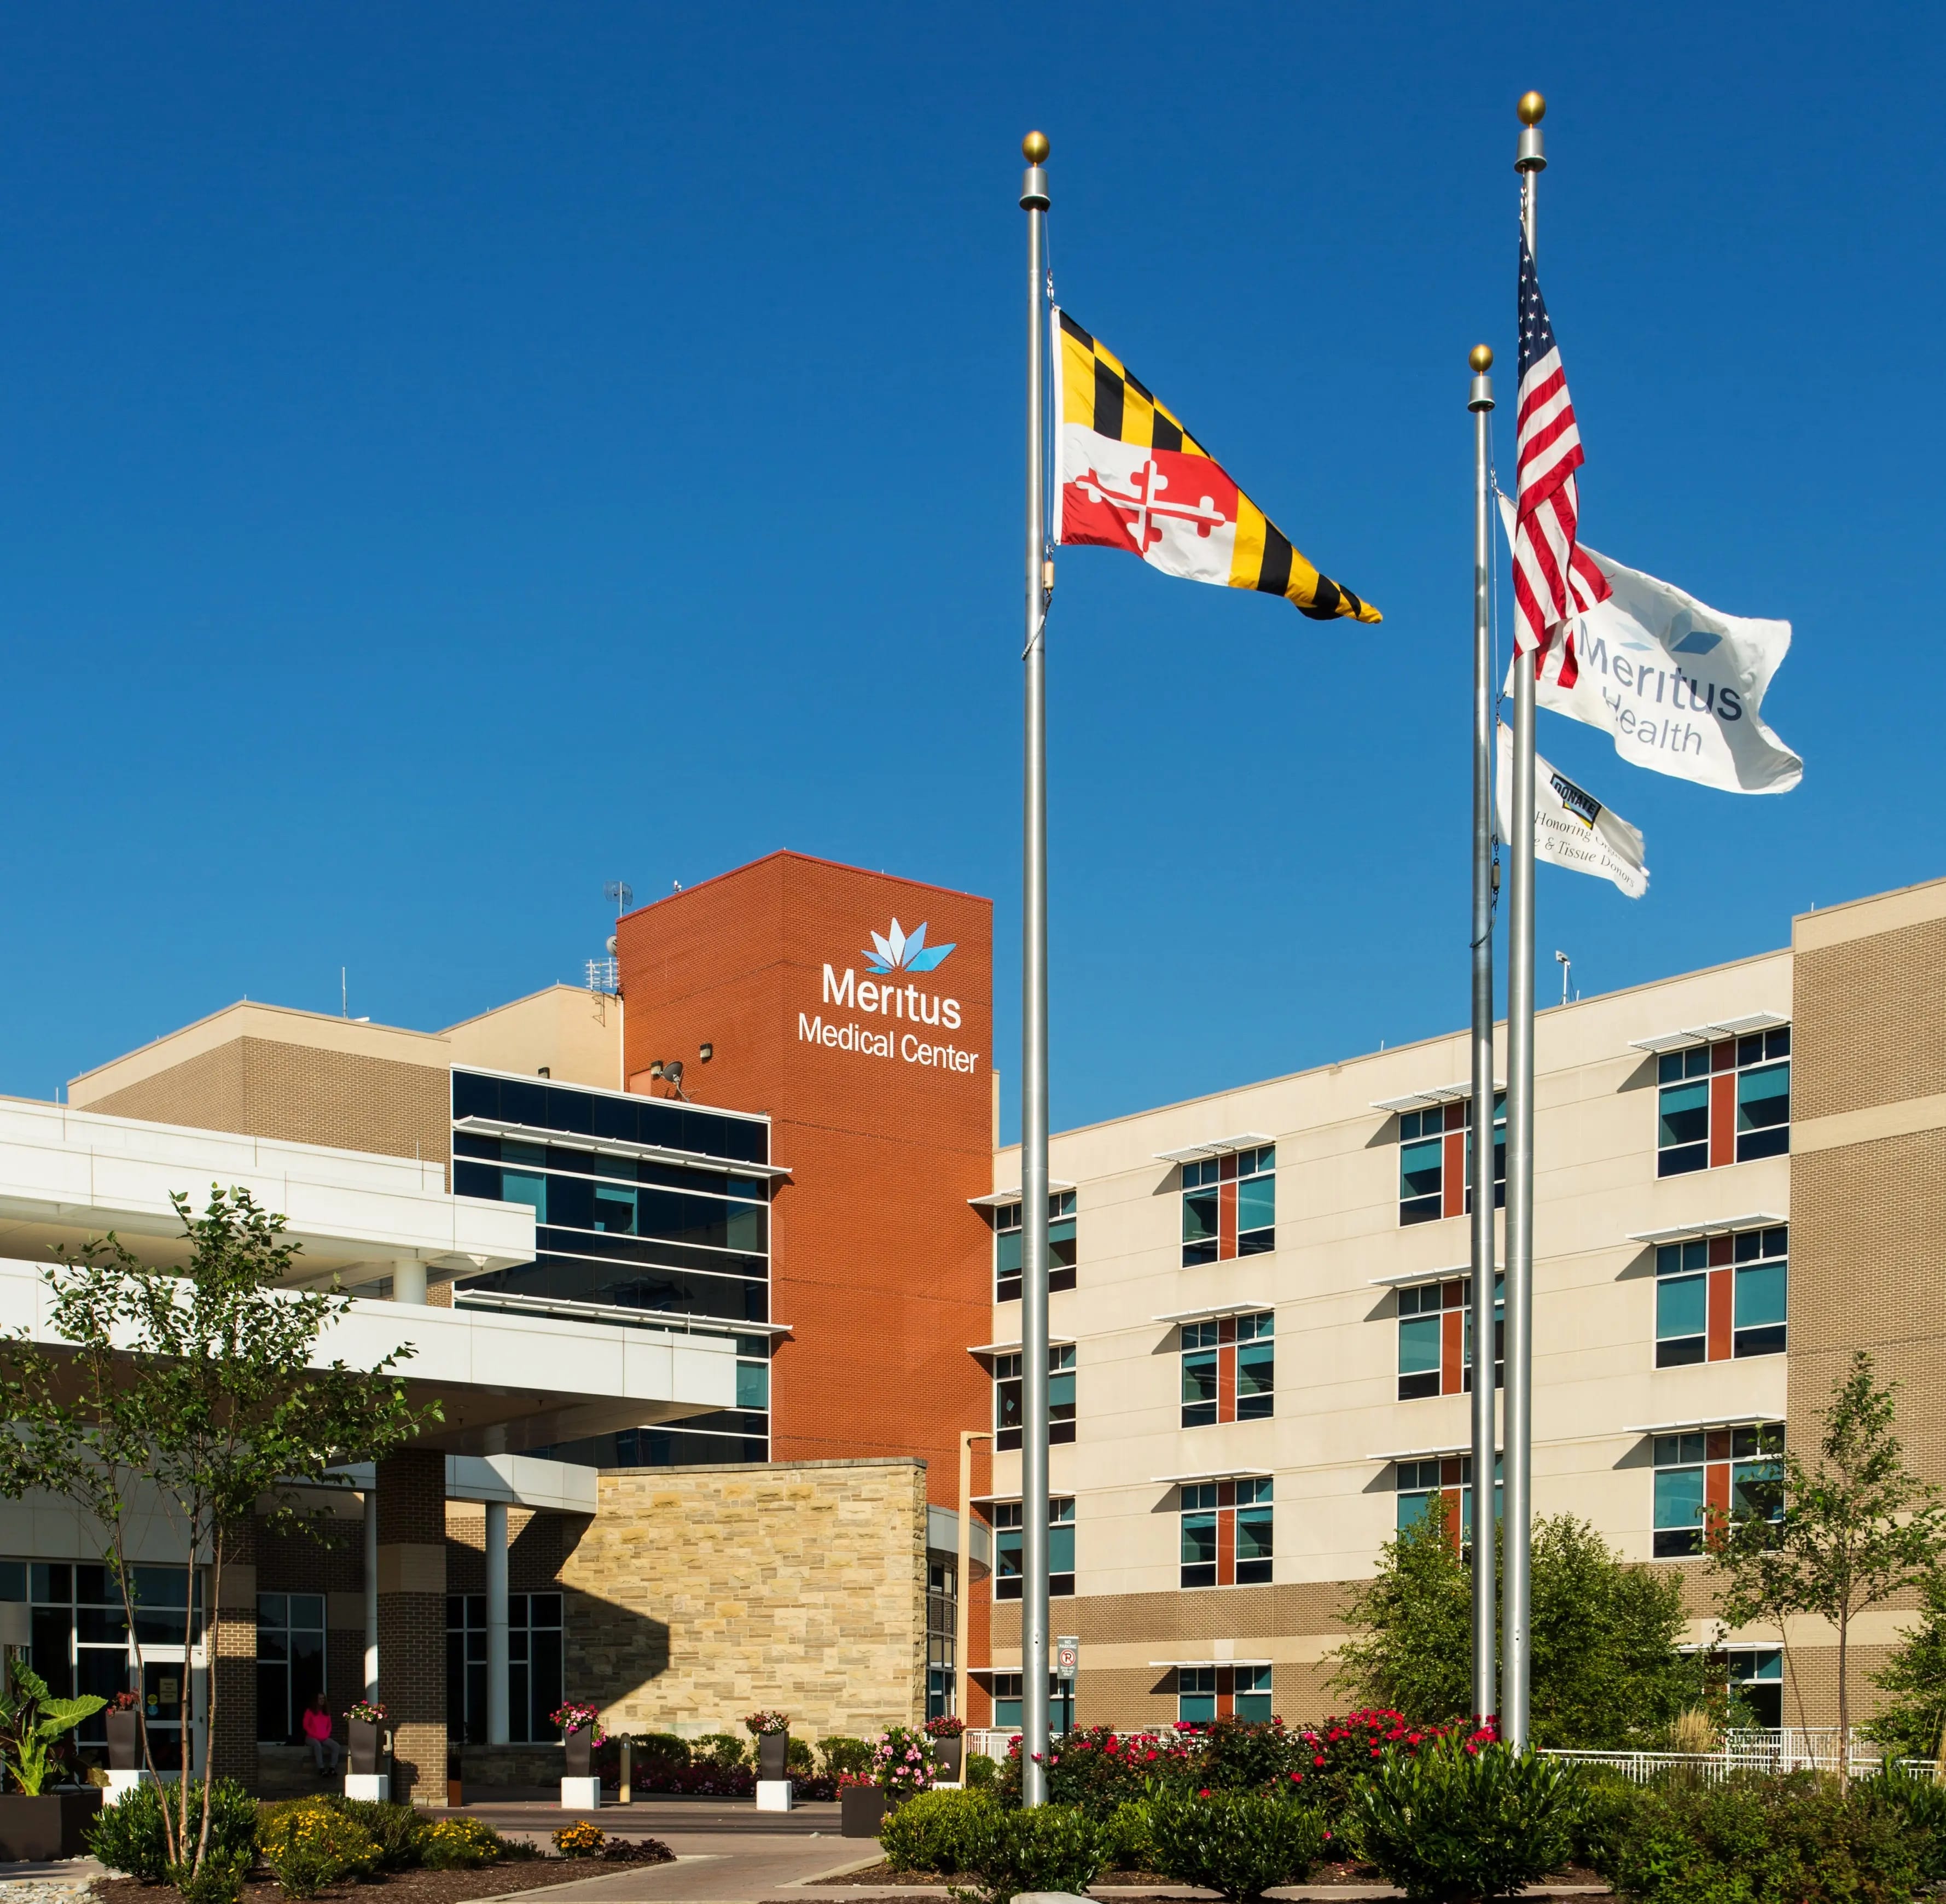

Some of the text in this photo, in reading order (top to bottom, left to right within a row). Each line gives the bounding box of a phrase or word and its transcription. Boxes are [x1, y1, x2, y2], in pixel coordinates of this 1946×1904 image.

[1579, 617, 1742, 721] Meritus
[1602, 686, 1702, 755] Health
[1535, 811, 1591, 843] Honoring
[1554, 782, 1596, 814] DONATE
[1545, 837, 1554, 851] &
[1558, 841, 1596, 862] Tissue
[1601, 855, 1634, 887] Donors
[823, 963, 961, 1029] Meritus
[799, 1012, 979, 1074] Medical Center
